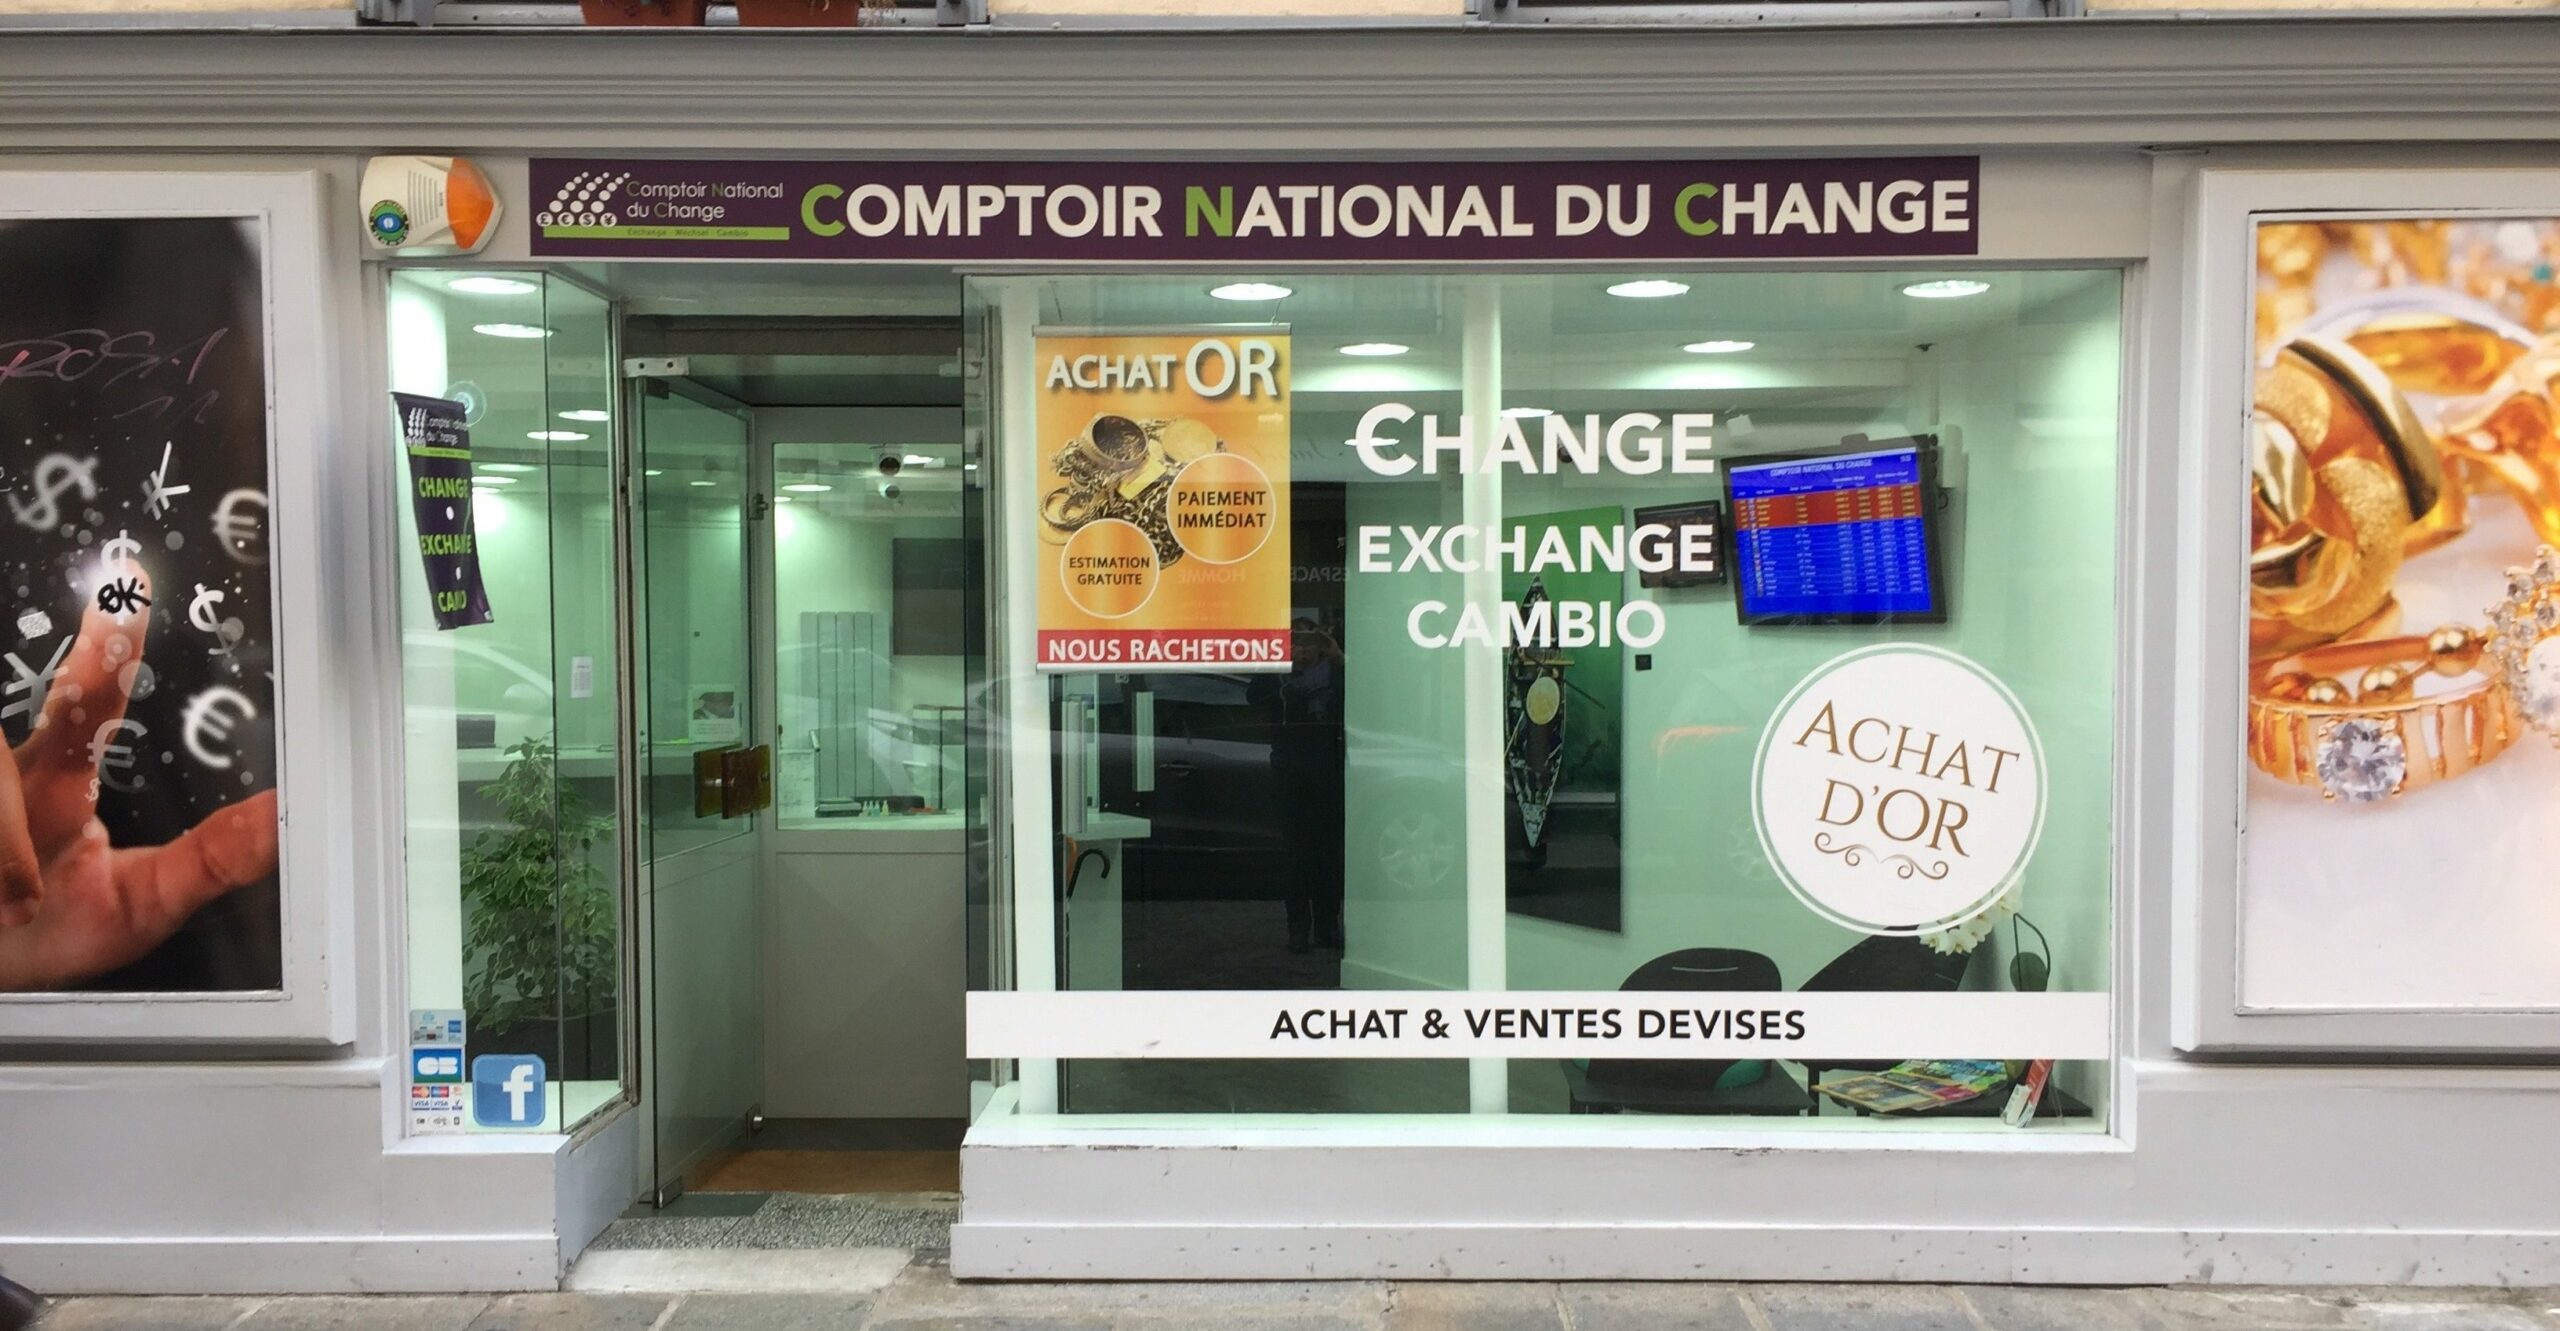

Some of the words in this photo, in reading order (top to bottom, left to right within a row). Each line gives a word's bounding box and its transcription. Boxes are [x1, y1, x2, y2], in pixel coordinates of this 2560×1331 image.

[626, 180, 707, 200] Comptoir
[711, 181, 783, 199] National
[626, 202, 649, 219] du
[653, 202, 725, 222] Change
[800, 184, 1163, 238] COMPTOIR
[1185, 184, 1534, 238] NATIONAL
[1555, 183, 1651, 237] DU
[1673, 180, 1970, 236] CHANGE
[1045, 354, 1177, 389] ACHAT
[1184, 338, 1278, 398] OR
[418, 476, 469, 498] CHANGE
[1177, 490, 1267, 506] PAIEMENT
[1177, 510, 1267, 528] IMMÉDIAT
[1358, 524, 1715, 573] EXCHANGE
[1069, 556, 1150, 569] ESTIMATION
[1077, 573, 1143, 585] GRATUITE
[1407, 599, 1666, 649] CAMBIO
[1049, 639, 1121, 661] NOUS
[1130, 638, 1284, 662] RACHETONS
[1792, 699, 2020, 794] ACHAT
[1816, 778, 1970, 858] D'OR
[1270, 1009, 1408, 1039] ACHAT
[1421, 1008, 1450, 1039] &
[1464, 1008, 1623, 1039] VENTES
[1638, 1009, 1806, 1041] DEVISES
[417, 1057, 458, 1075] CB
